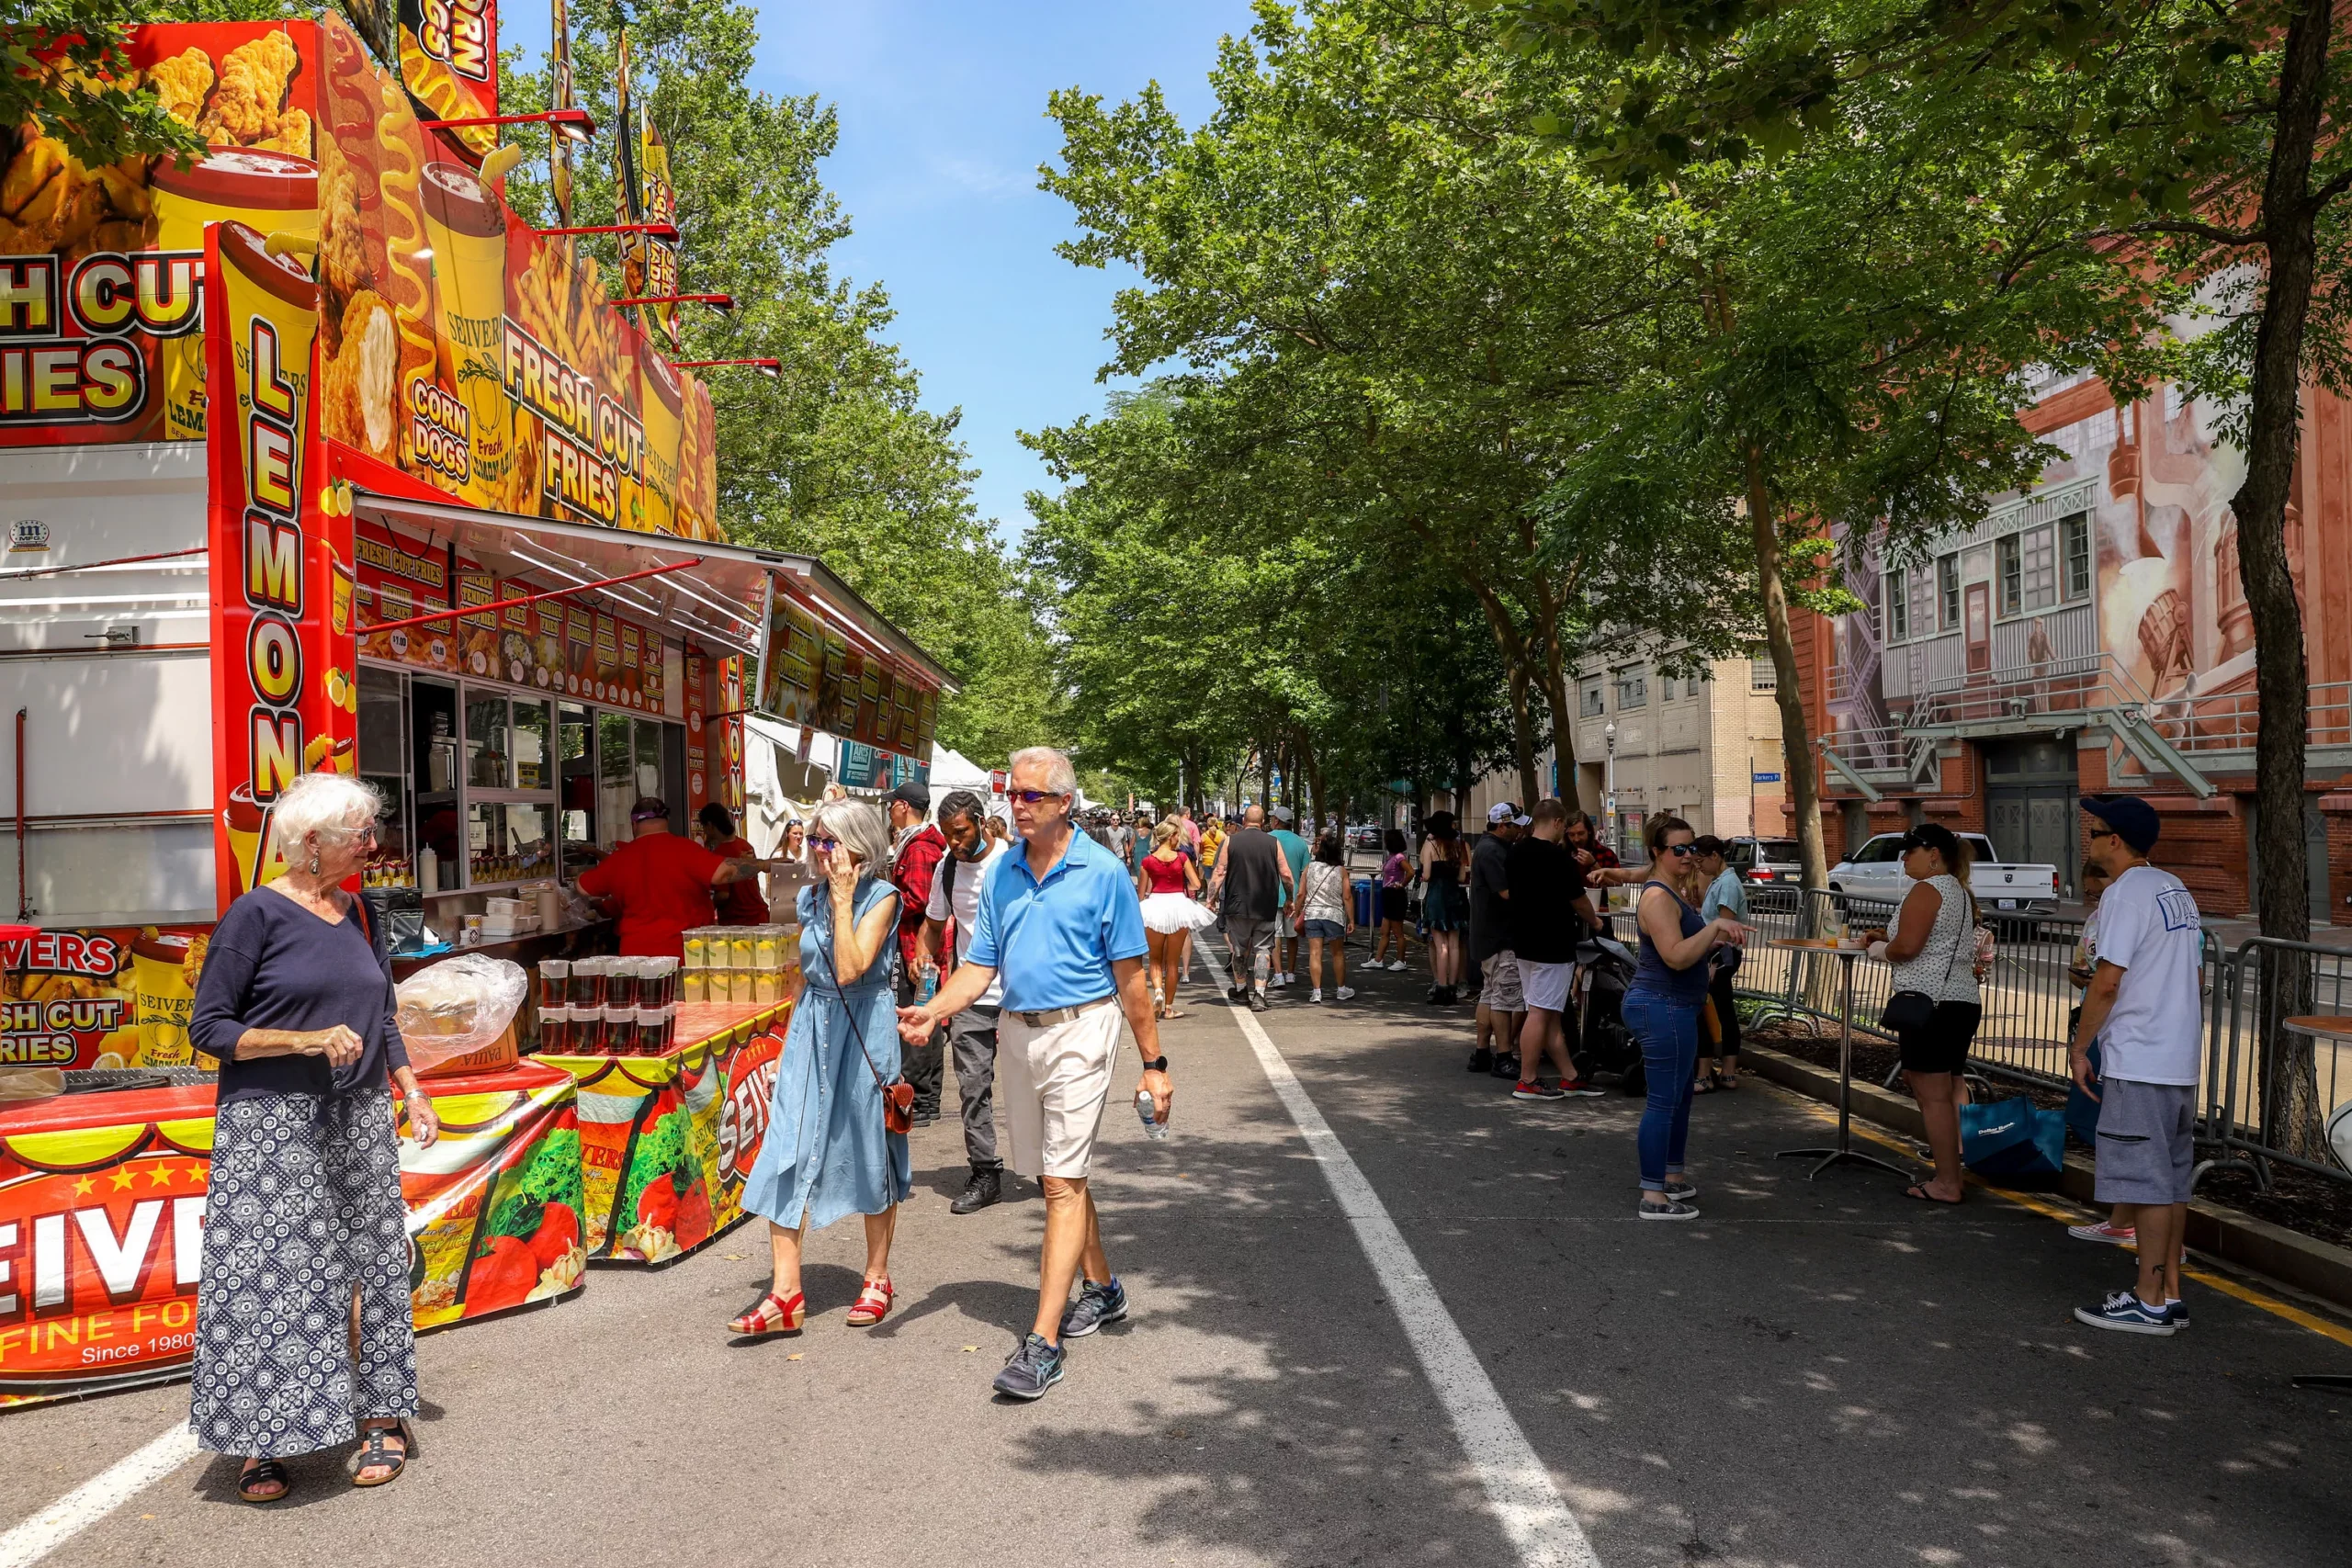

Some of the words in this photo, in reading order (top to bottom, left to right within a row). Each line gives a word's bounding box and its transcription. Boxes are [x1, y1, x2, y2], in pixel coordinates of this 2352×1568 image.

[79, 261, 204, 324] CU
[413, 382, 467, 440] CORN
[504, 325, 594, 445] FRESH
[600, 402, 643, 479] CUT
[415, 423, 467, 476] DOGS
[476, 432, 503, 457] Fresh
[545, 431, 616, 524] FRIES
[356, 538, 390, 567] FRESH
[392, 550, 413, 574] CUT
[414, 558, 442, 586] FRIES
[382, 584, 412, 605] MEDIUM
[462, 586, 494, 606] TENDERS
[382, 601, 412, 621] BUCKET
[478, 611, 496, 629] FRIES
[506, 607, 526, 625] FRIES
[689, 759, 704, 769] BUCKET
[49, 1002, 119, 1029] CUT
[151, 1048, 181, 1059] Fresh
[1978, 1127, 1998, 1135] Dollar
[1998, 1122, 2016, 1131] Bank
[0, 1310, 114, 1362] FINE
[134, 1301, 198, 1333] FO
[82, 1344, 140, 1364] Since
[148, 1333, 195, 1353] 1980
